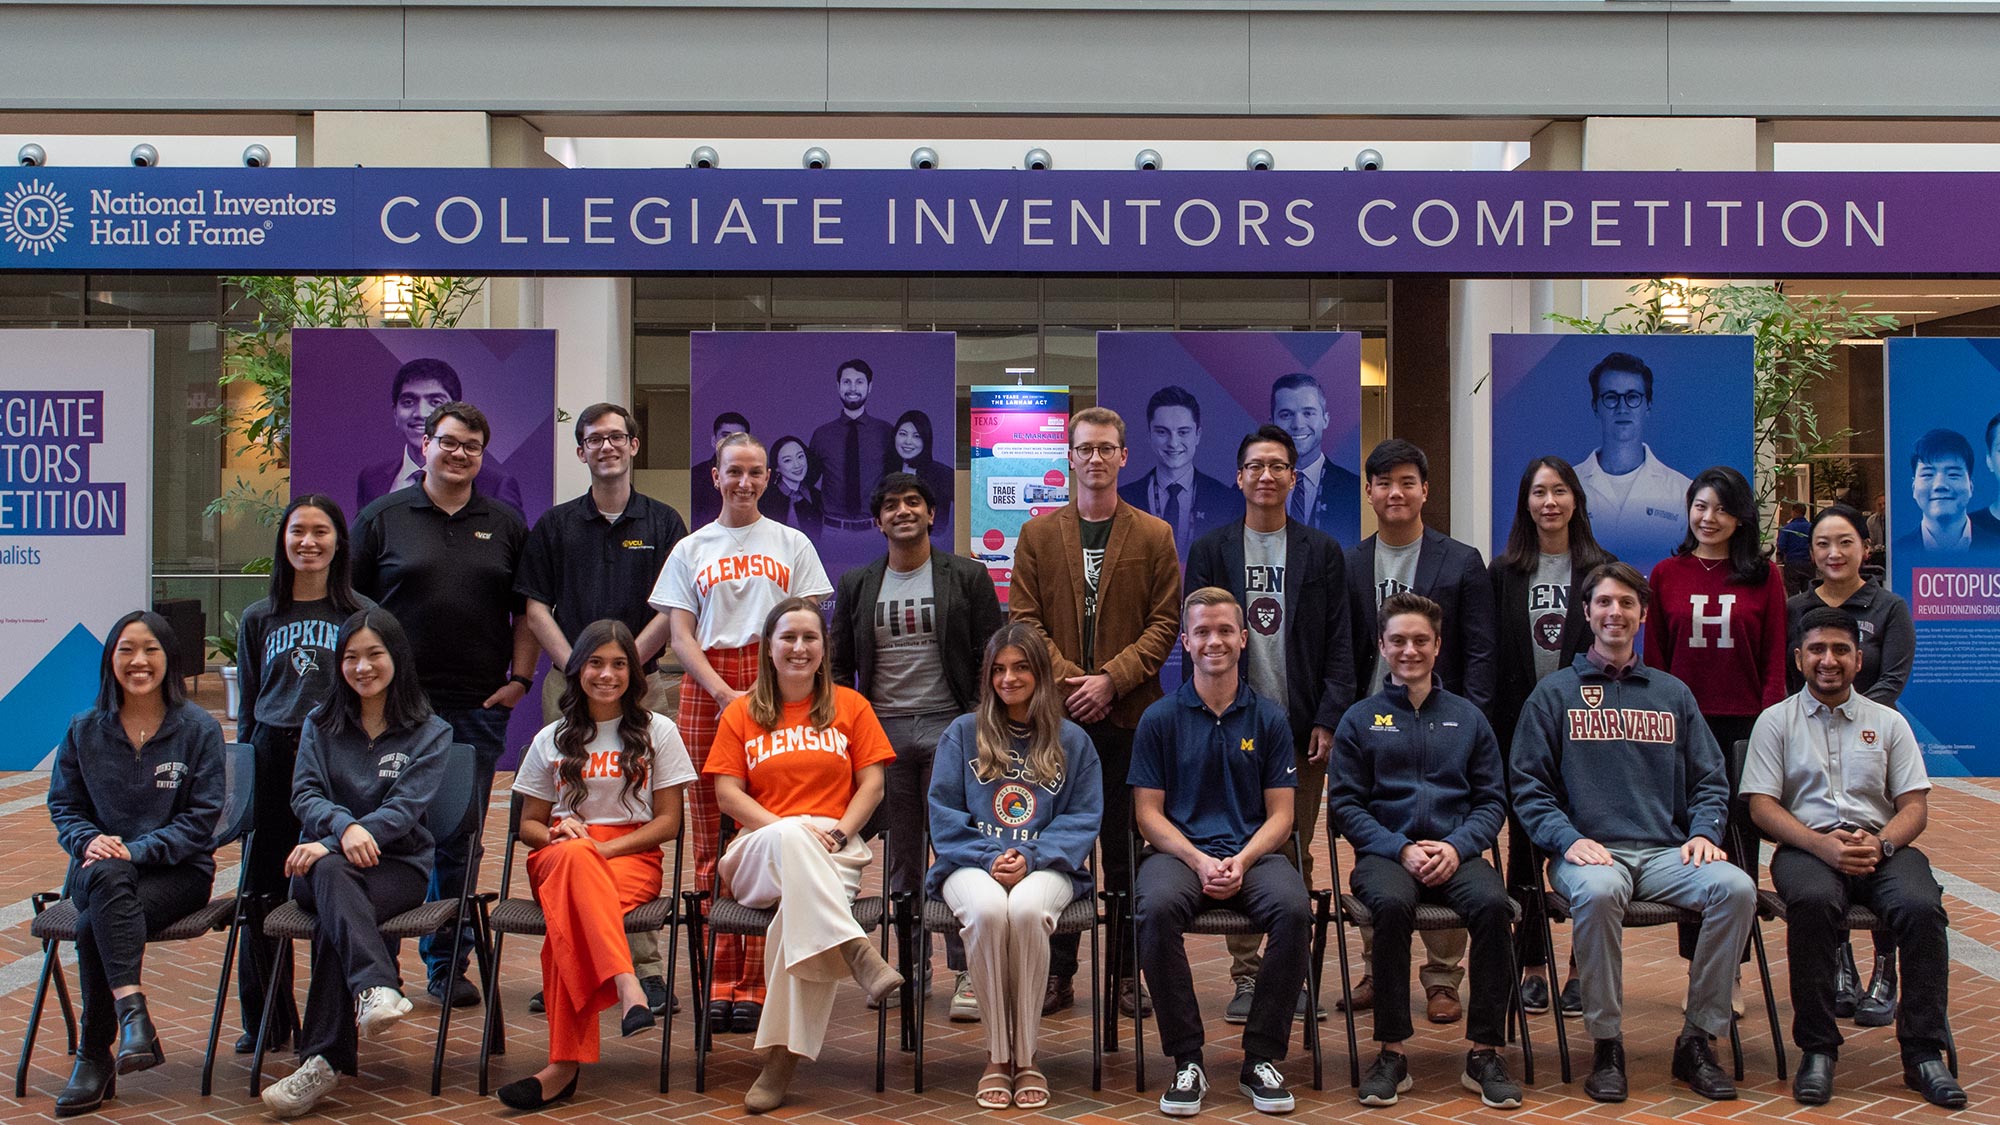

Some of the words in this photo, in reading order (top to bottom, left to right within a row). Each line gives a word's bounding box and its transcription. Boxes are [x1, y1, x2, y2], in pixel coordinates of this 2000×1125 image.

[90, 189, 205, 215] National
[213, 189, 337, 216] Inventors
[90, 219, 150, 245] Hall
[155, 219, 180, 245] of
[380, 196, 844, 245] COLLEGIATE
[888, 198, 1316, 247] INVENTORS
[1357, 199, 1886, 248] COMPETITION
[0, 398, 95, 437] GIATE
[974, 416, 998, 426] TEXAS
[1, 444, 81, 483] TORS
[993, 486, 1015, 495] TRADE
[993, 496, 1016, 504] DRESS
[0, 546, 41, 565] alists
[696, 554, 790, 598] CLEMSON
[1689, 594, 1736, 648] H
[1918, 604, 1981, 615] REVOLUTIONIZING
[1374, 714, 1394, 726] M
[1568, 708, 1676, 744] HARVARD
[745, 725, 848, 770] CLEMSON
[1240, 737, 1255, 751] M
[977, 822, 1003, 838] EST
